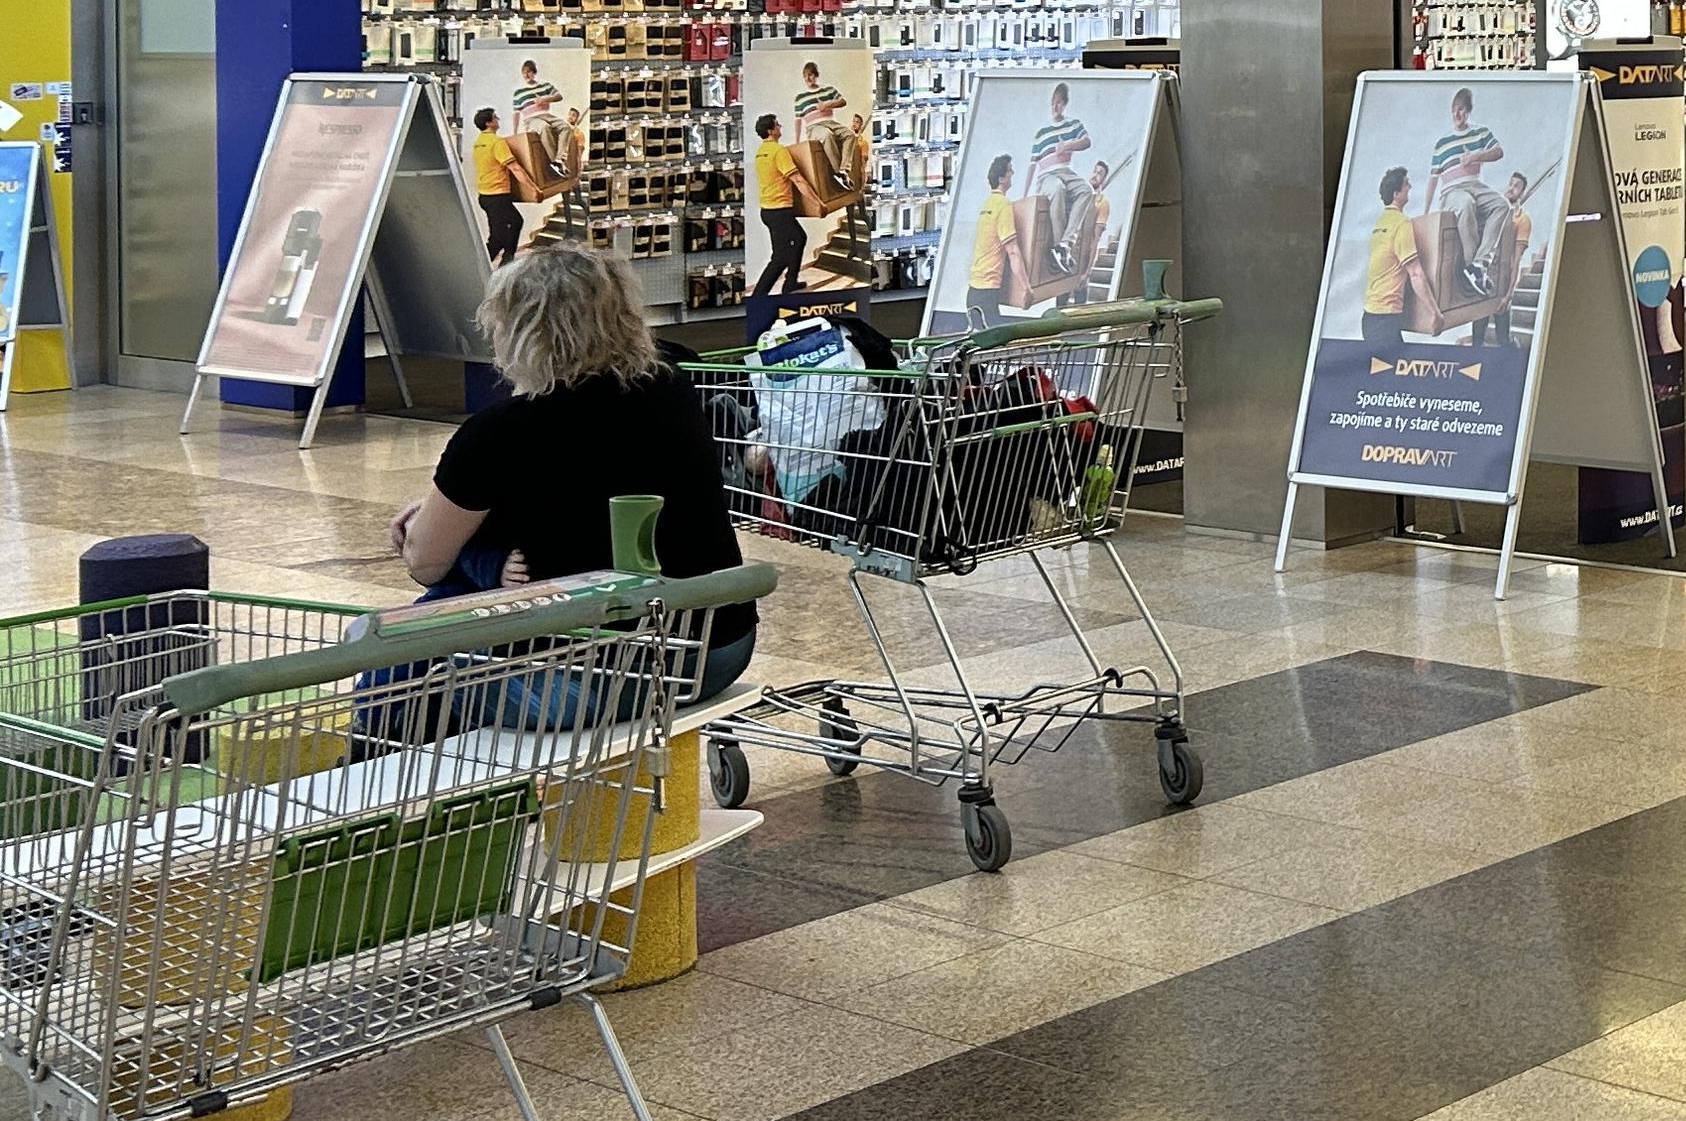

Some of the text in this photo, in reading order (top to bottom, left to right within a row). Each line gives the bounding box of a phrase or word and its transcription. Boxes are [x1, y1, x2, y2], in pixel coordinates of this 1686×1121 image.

[1619, 64, 1675, 84] DATART
[1635, 268, 1670, 284] NOVINKA
[800, 302, 844, 317] DATART
[1395, 358, 1460, 379] DATART
[1356, 390, 1483, 416] Spotřebiče vyneseme,
[1329, 412, 1504, 437] zapojíme a ty staré odvezeme
[1361, 444, 1459, 468] DOPRAVART
